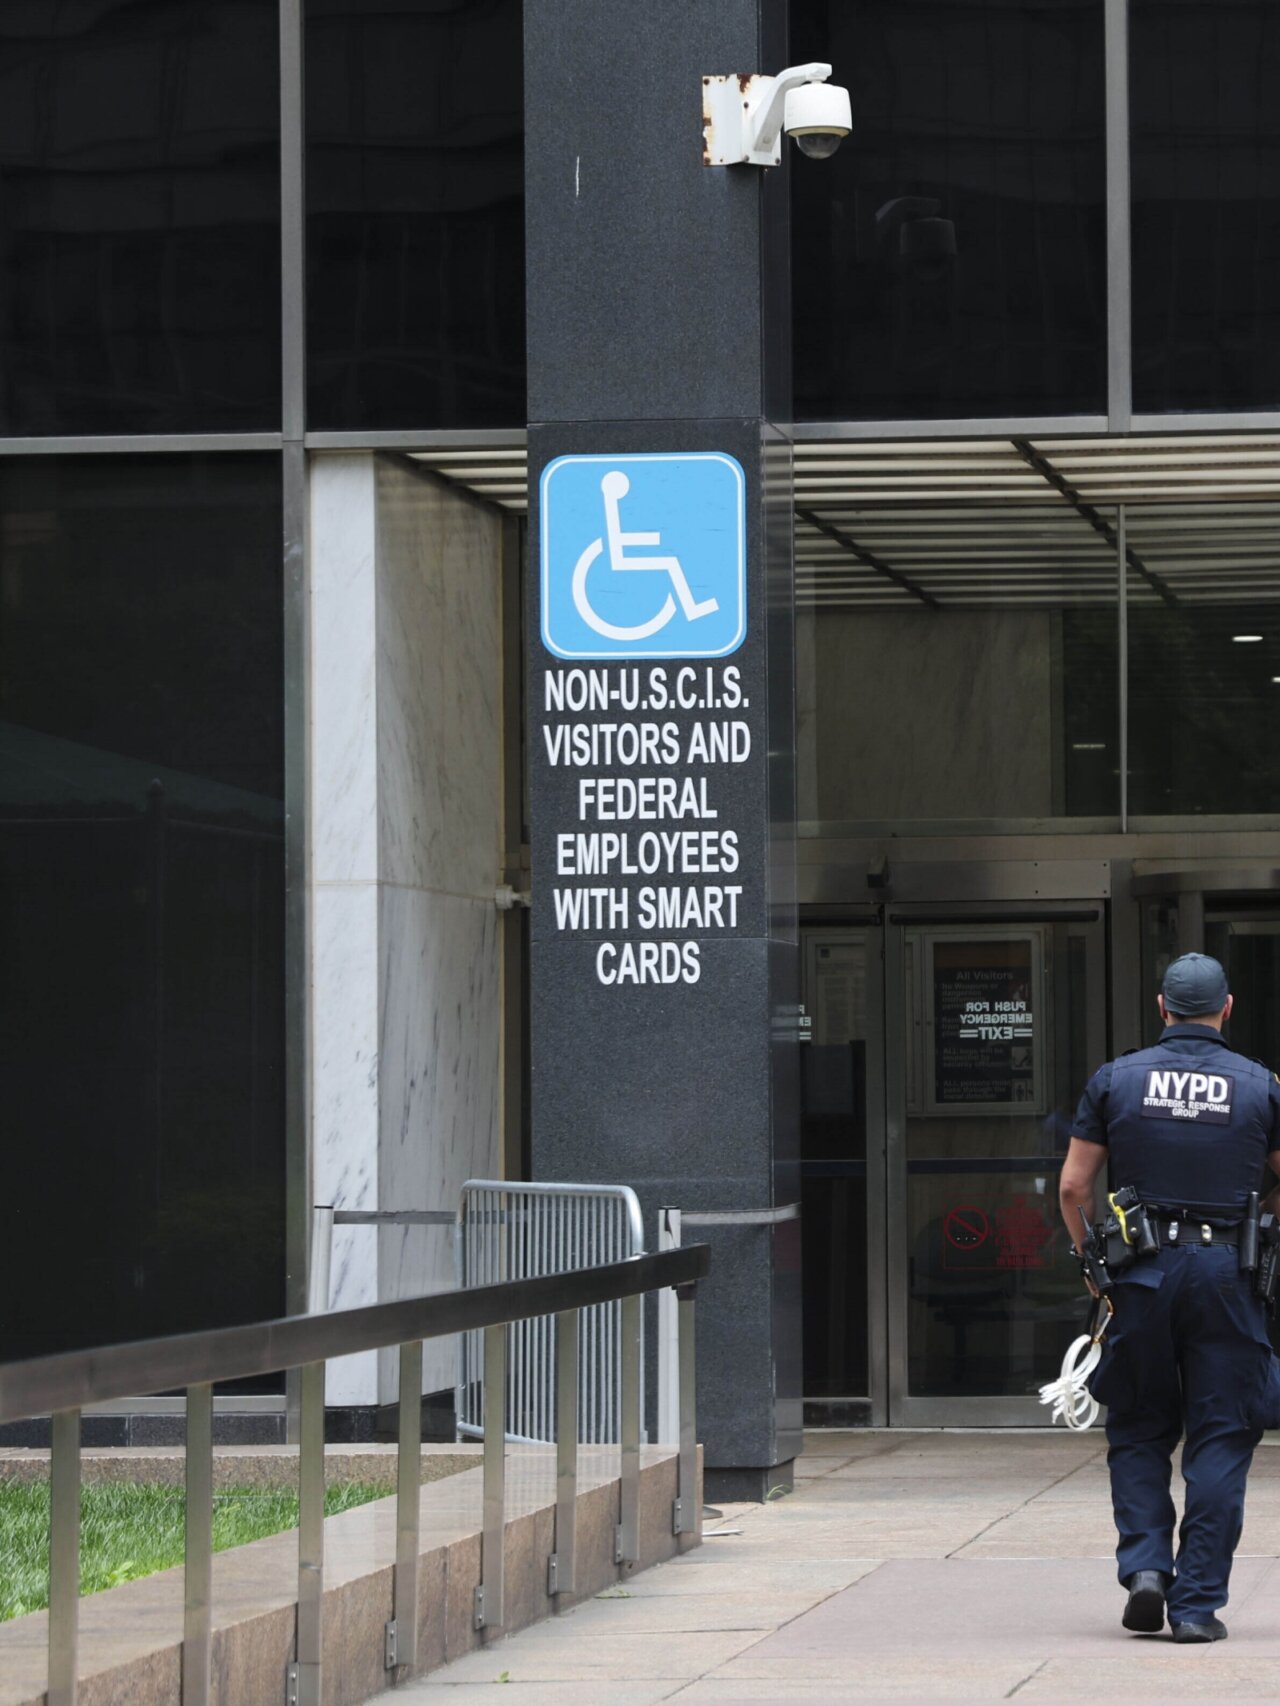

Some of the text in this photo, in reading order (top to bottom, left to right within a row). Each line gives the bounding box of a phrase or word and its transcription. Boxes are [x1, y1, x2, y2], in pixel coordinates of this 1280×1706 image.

[544, 666, 749, 711] NON-U.S.C.I.S.
[543, 721, 751, 766] VISITORS AND
[579, 777, 717, 820] FEDERAL
[557, 830, 739, 875] EMPLOYEES
[553, 886, 742, 930] WITH SMART
[596, 941, 701, 985] CARDS
[974, 971, 1013, 980] Visitors
[1143, 1097, 1231, 1113] STRATEGIC RESPONSE
[1148, 1071, 1228, 1104] NYPD
[1172, 1108, 1199, 1118] GROUP
